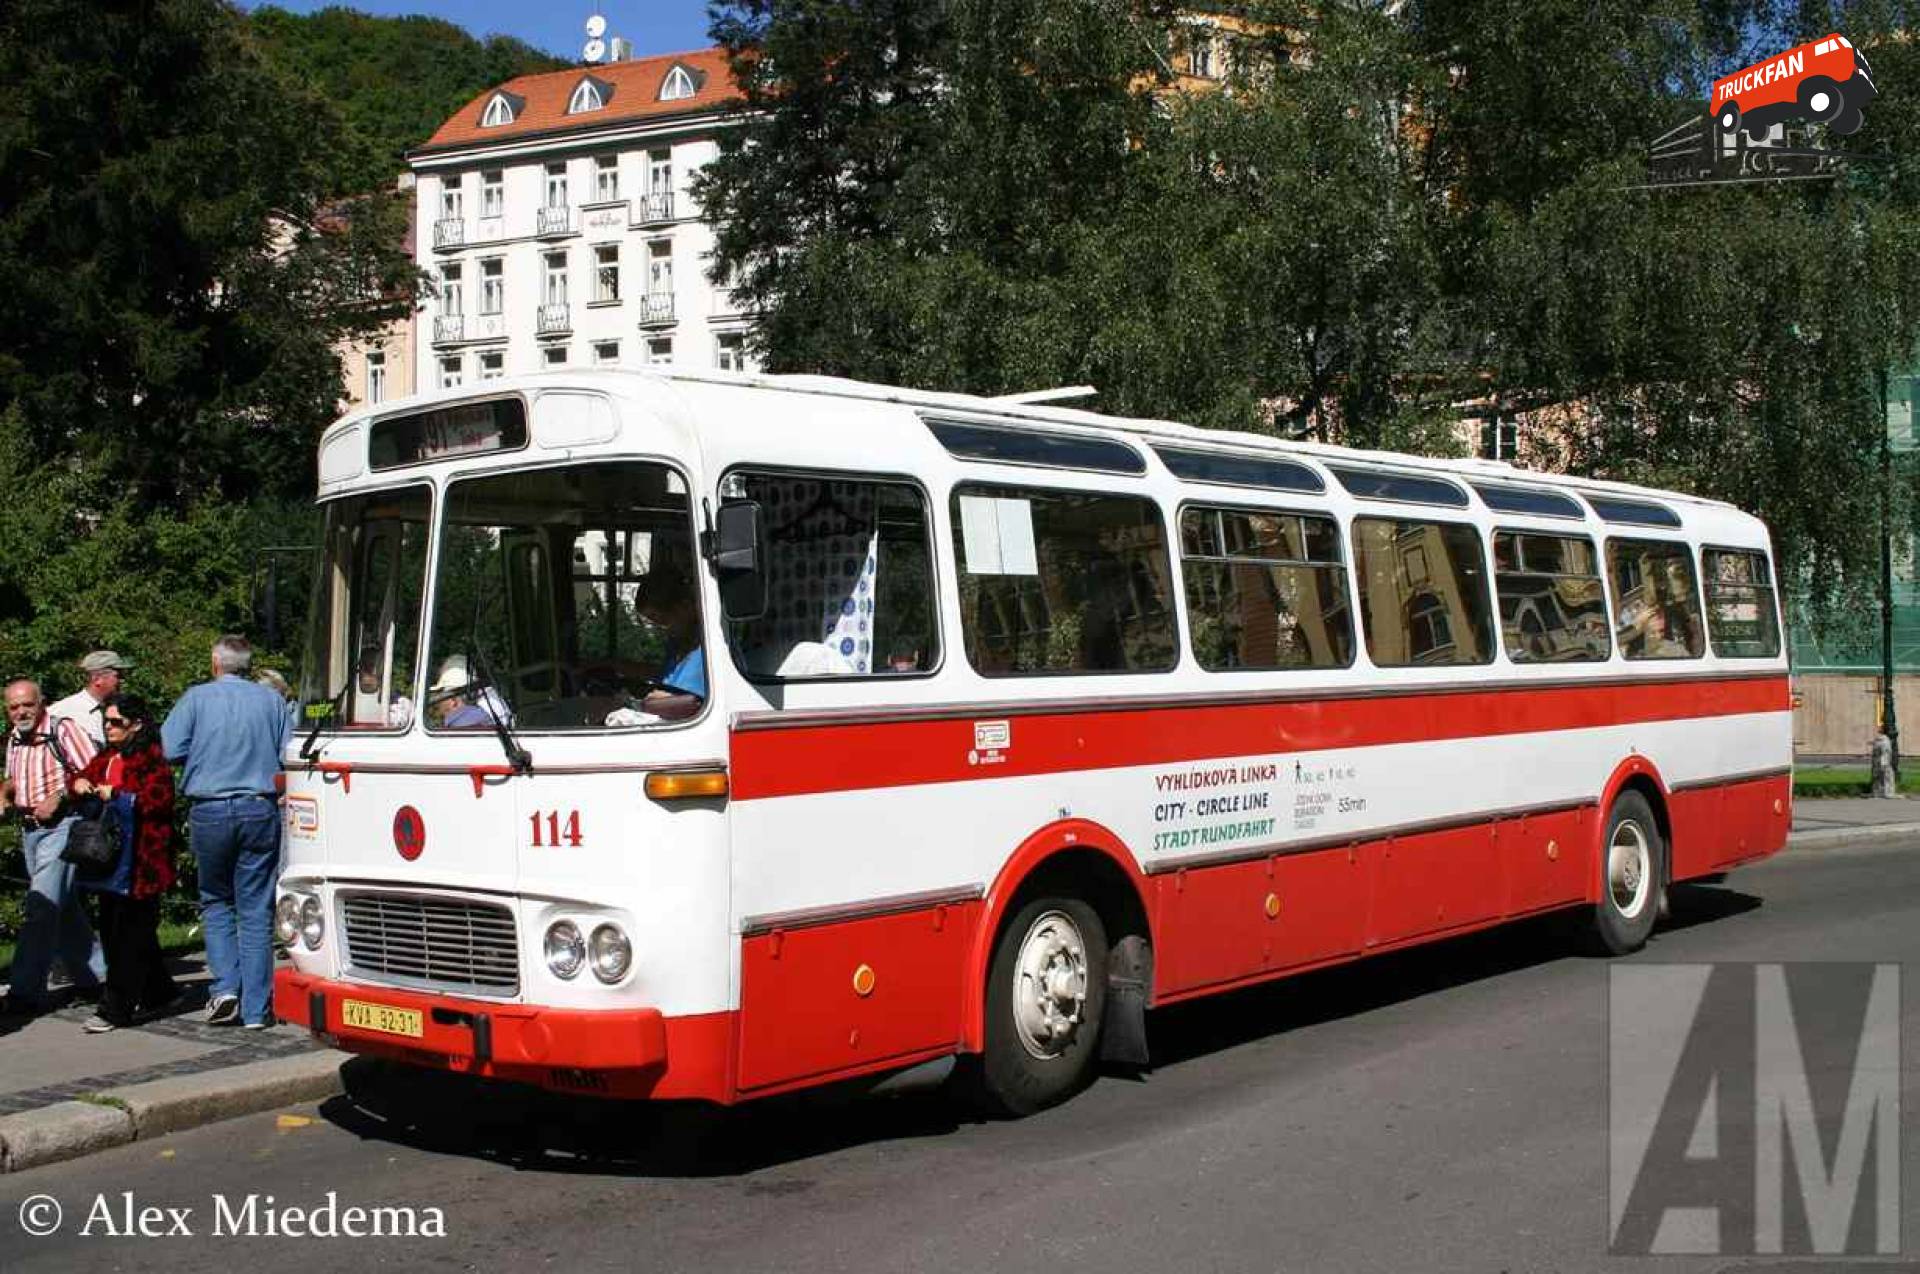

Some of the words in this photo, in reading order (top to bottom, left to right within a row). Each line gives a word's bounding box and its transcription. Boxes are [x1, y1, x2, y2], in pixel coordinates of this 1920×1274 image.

[1155, 765, 1237, 792] VYHLÍDKOVÁ
[1240, 764, 1277, 784] LINKA
[1154, 802, 1186, 822] CITY
[1196, 795, 1240, 816] CIRCLE
[1242, 792, 1269, 811] LINE
[530, 810, 583, 847] 114
[349, 1004, 371, 1024] KVA
